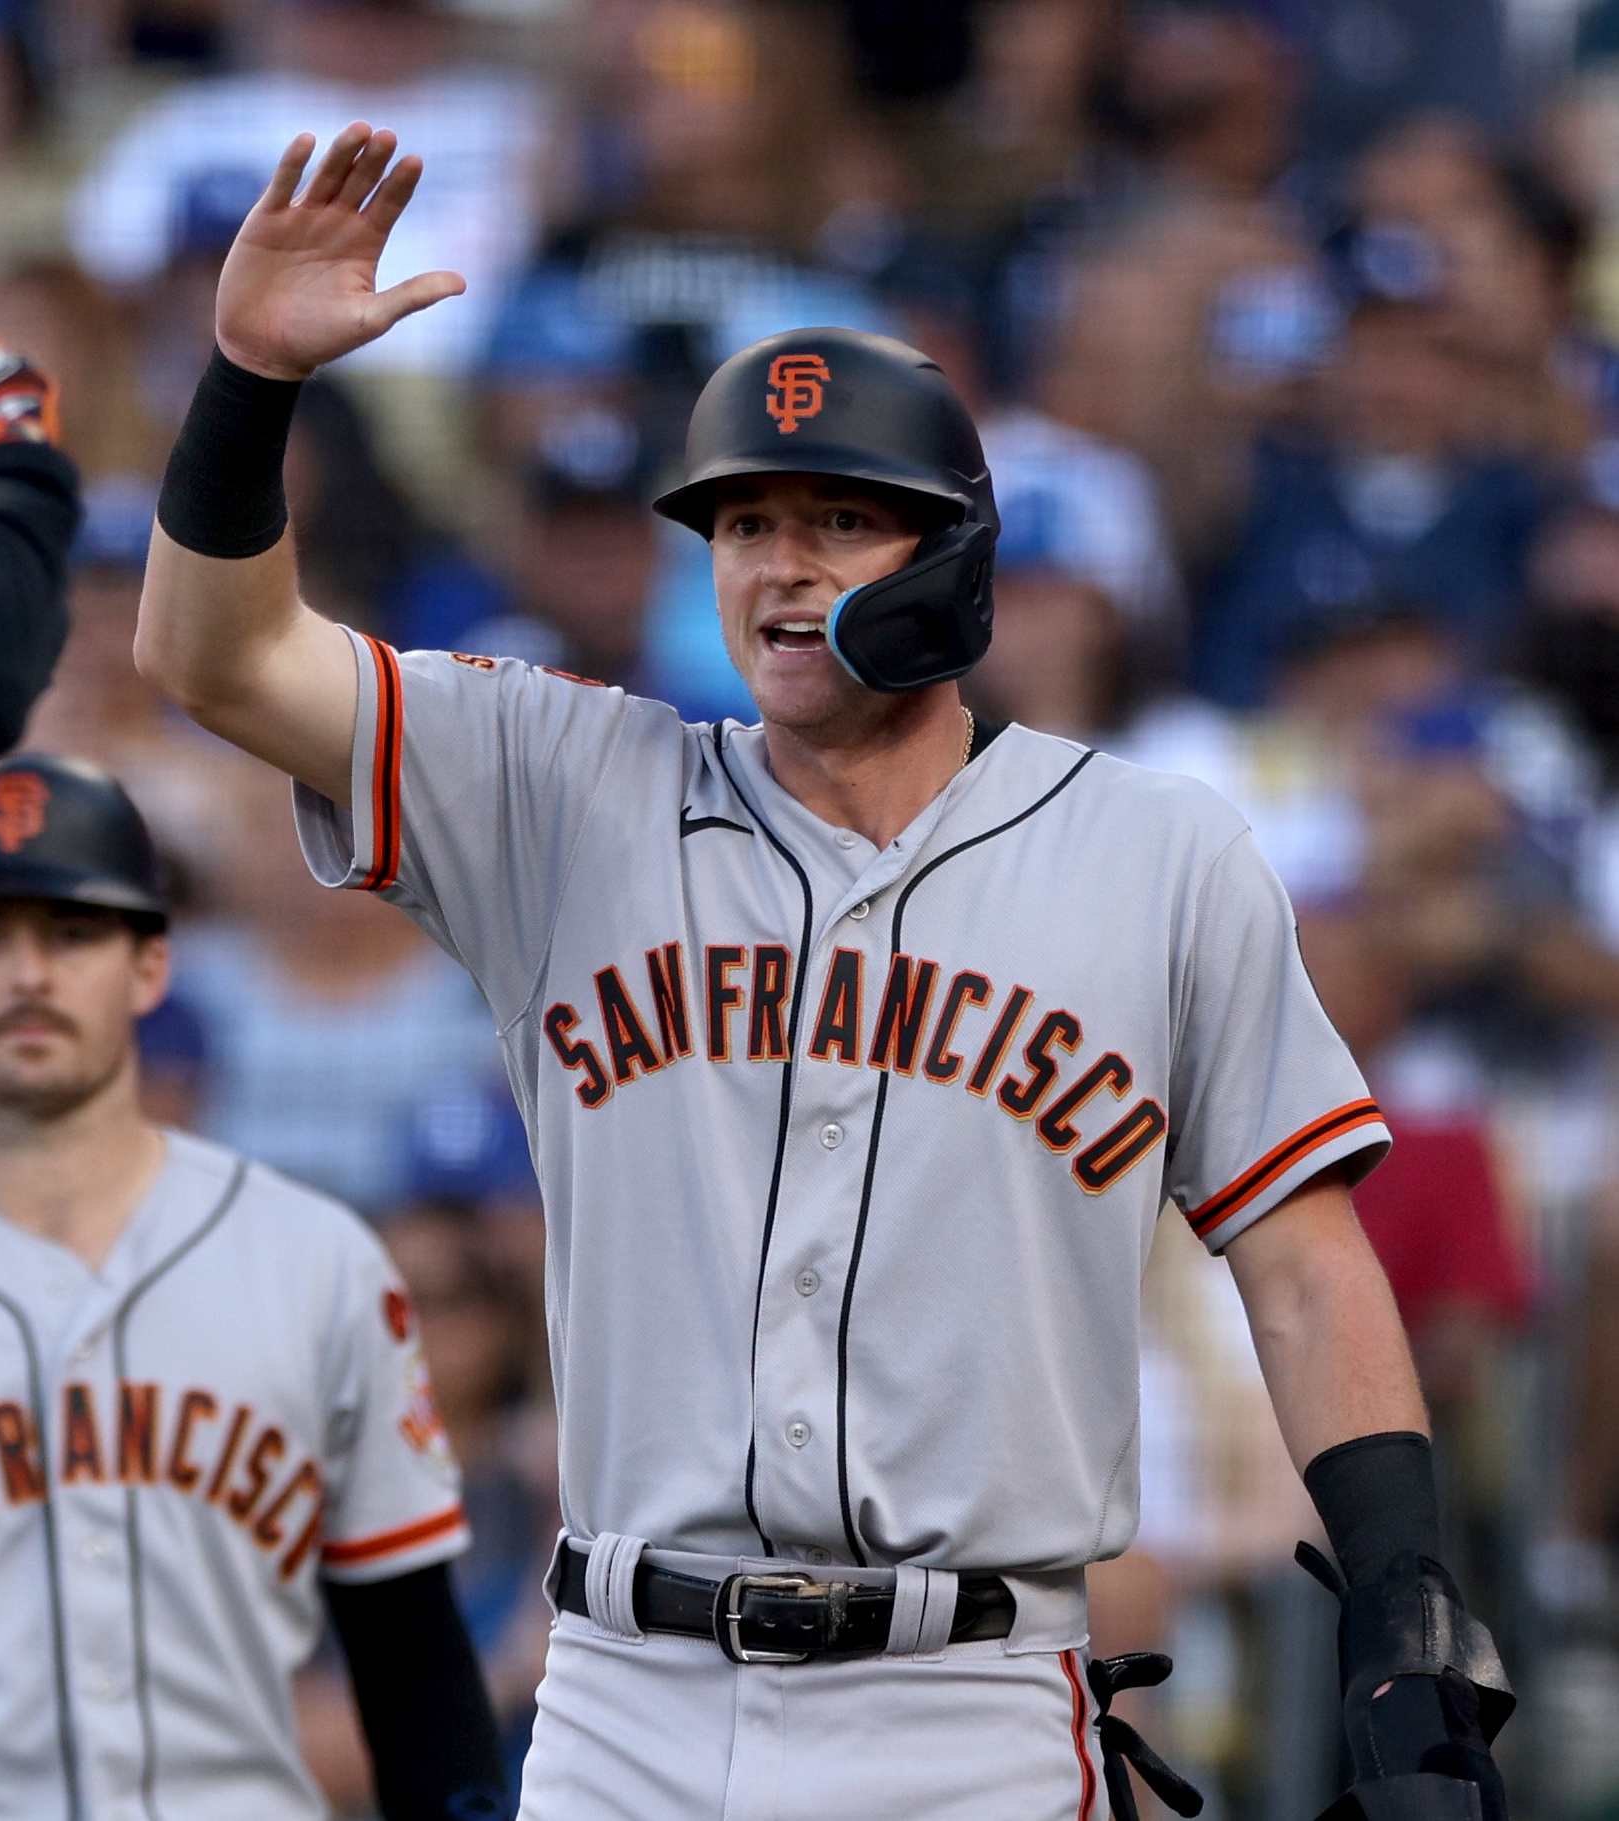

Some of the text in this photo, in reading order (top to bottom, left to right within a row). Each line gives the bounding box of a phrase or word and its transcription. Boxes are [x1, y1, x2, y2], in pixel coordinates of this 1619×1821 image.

[766, 354, 832, 433] SF
[543, 940, 1165, 1196] SAN FRANCISCO
